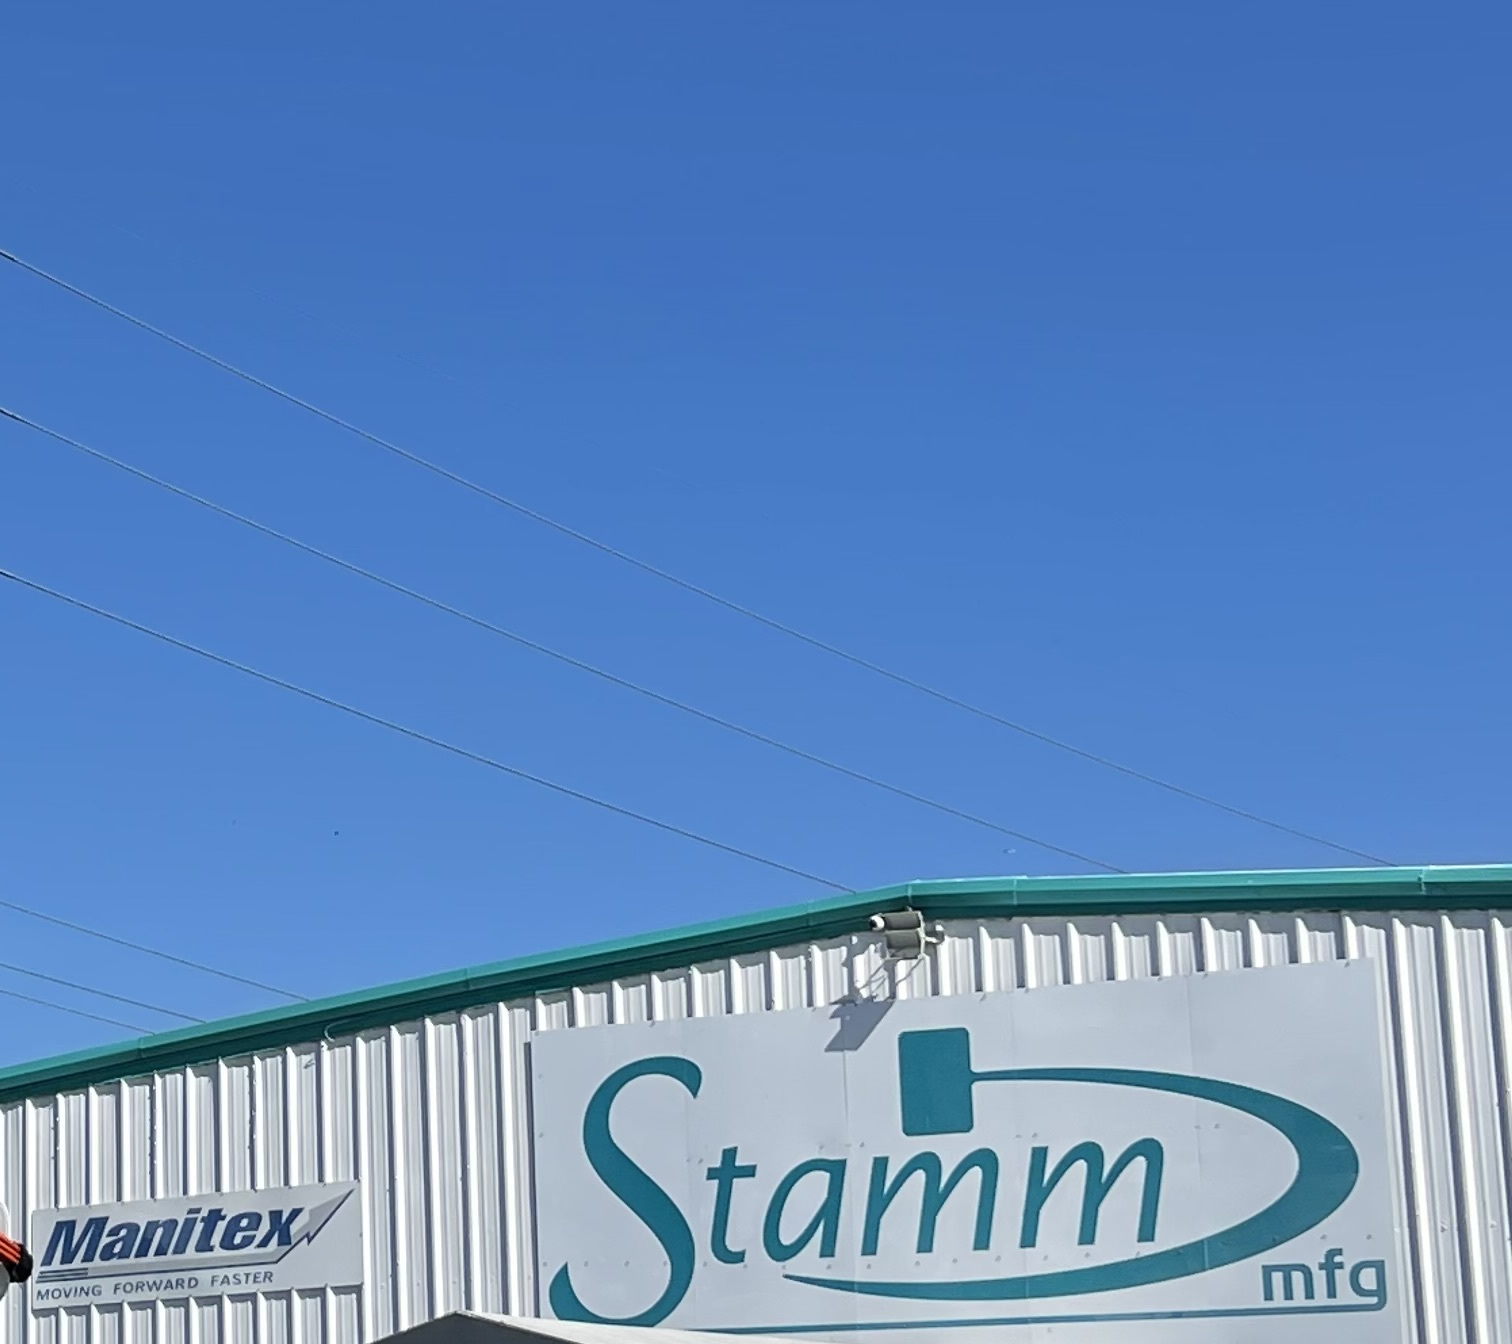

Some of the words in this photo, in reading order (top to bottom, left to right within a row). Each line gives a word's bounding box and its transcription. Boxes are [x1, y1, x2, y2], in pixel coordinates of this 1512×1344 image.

[549, 1054, 1165, 1328] Stamm
[39, 1206, 305, 1267] Manitex
[36, 1284, 103, 1301] MOVING
[113, 1276, 199, 1296] FORWARD
[210, 1270, 274, 1288] FASTER
[1261, 1248, 1387, 1312] mfg
